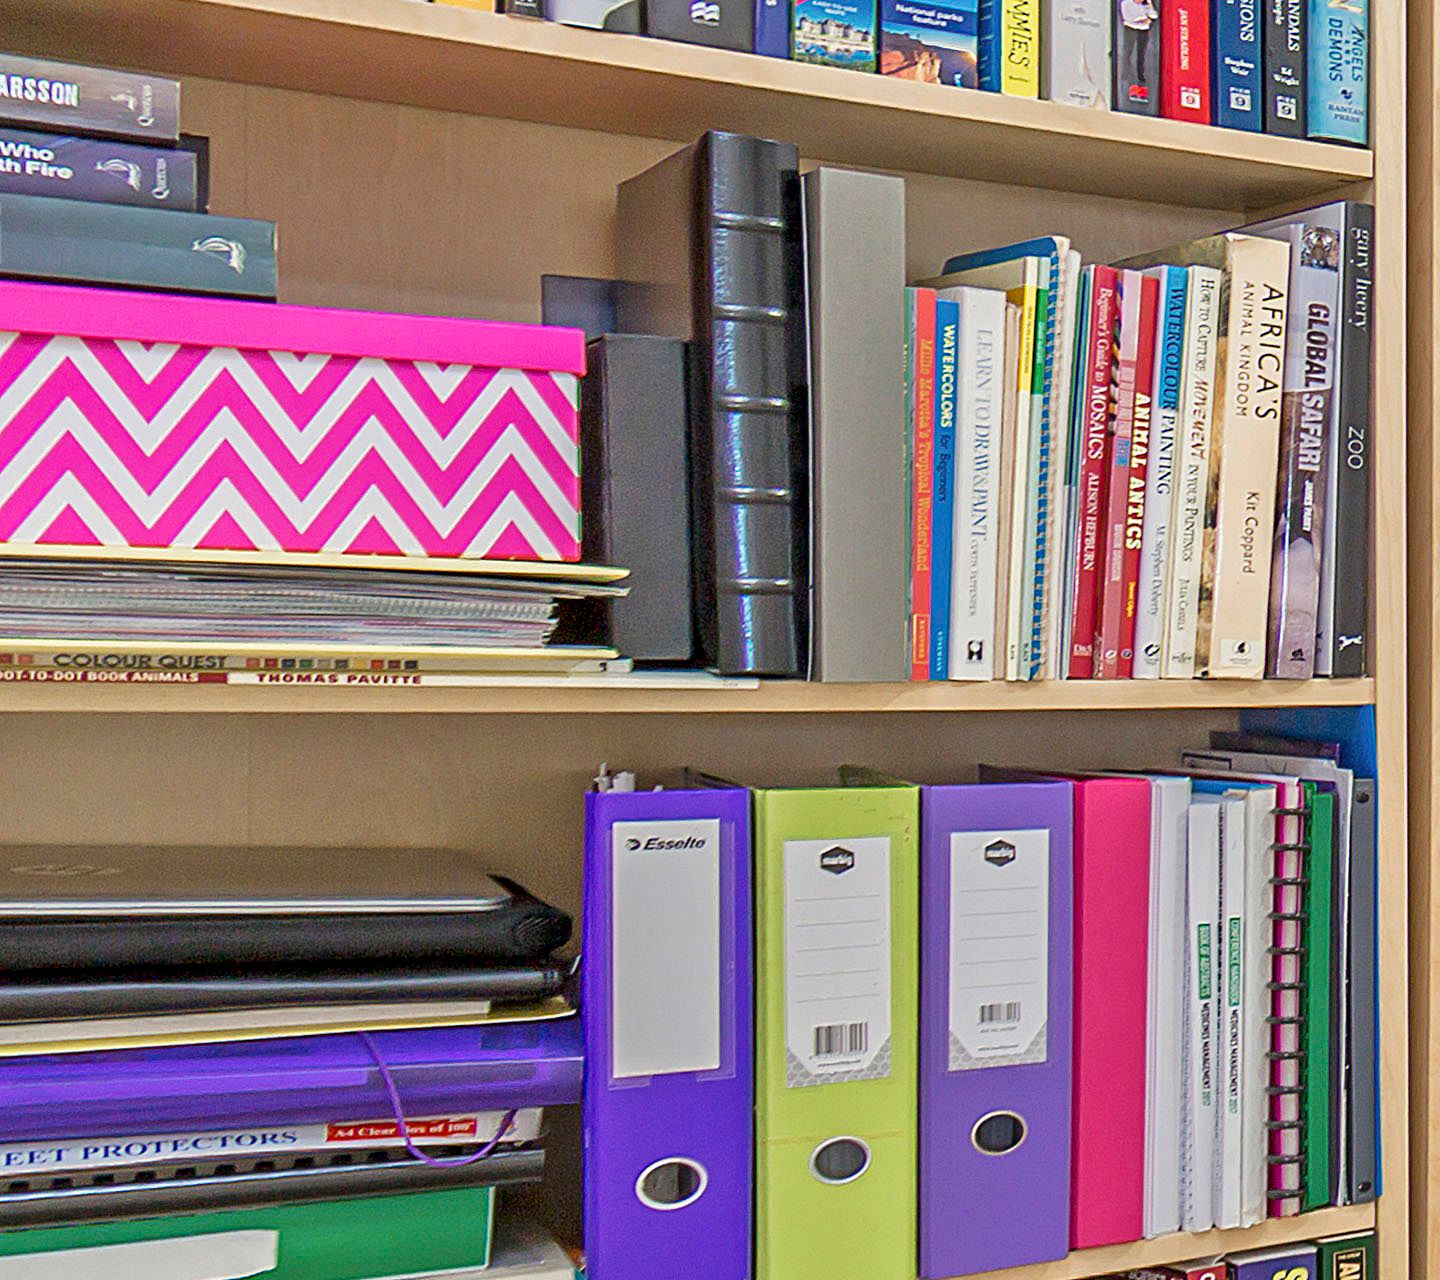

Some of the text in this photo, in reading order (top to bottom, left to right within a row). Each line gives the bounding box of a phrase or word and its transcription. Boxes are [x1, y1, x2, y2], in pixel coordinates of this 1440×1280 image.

[1235, 281, 1254, 417] ANIMAL KINGDOM
[1255, 283, 1284, 420] AFRICA'S
[1298, 302, 1330, 472] GLOBAL SAFARI
[1126, 393, 1151, 550] ANIMAL ANTICS
[1347, 426, 1365, 469] ZOO
